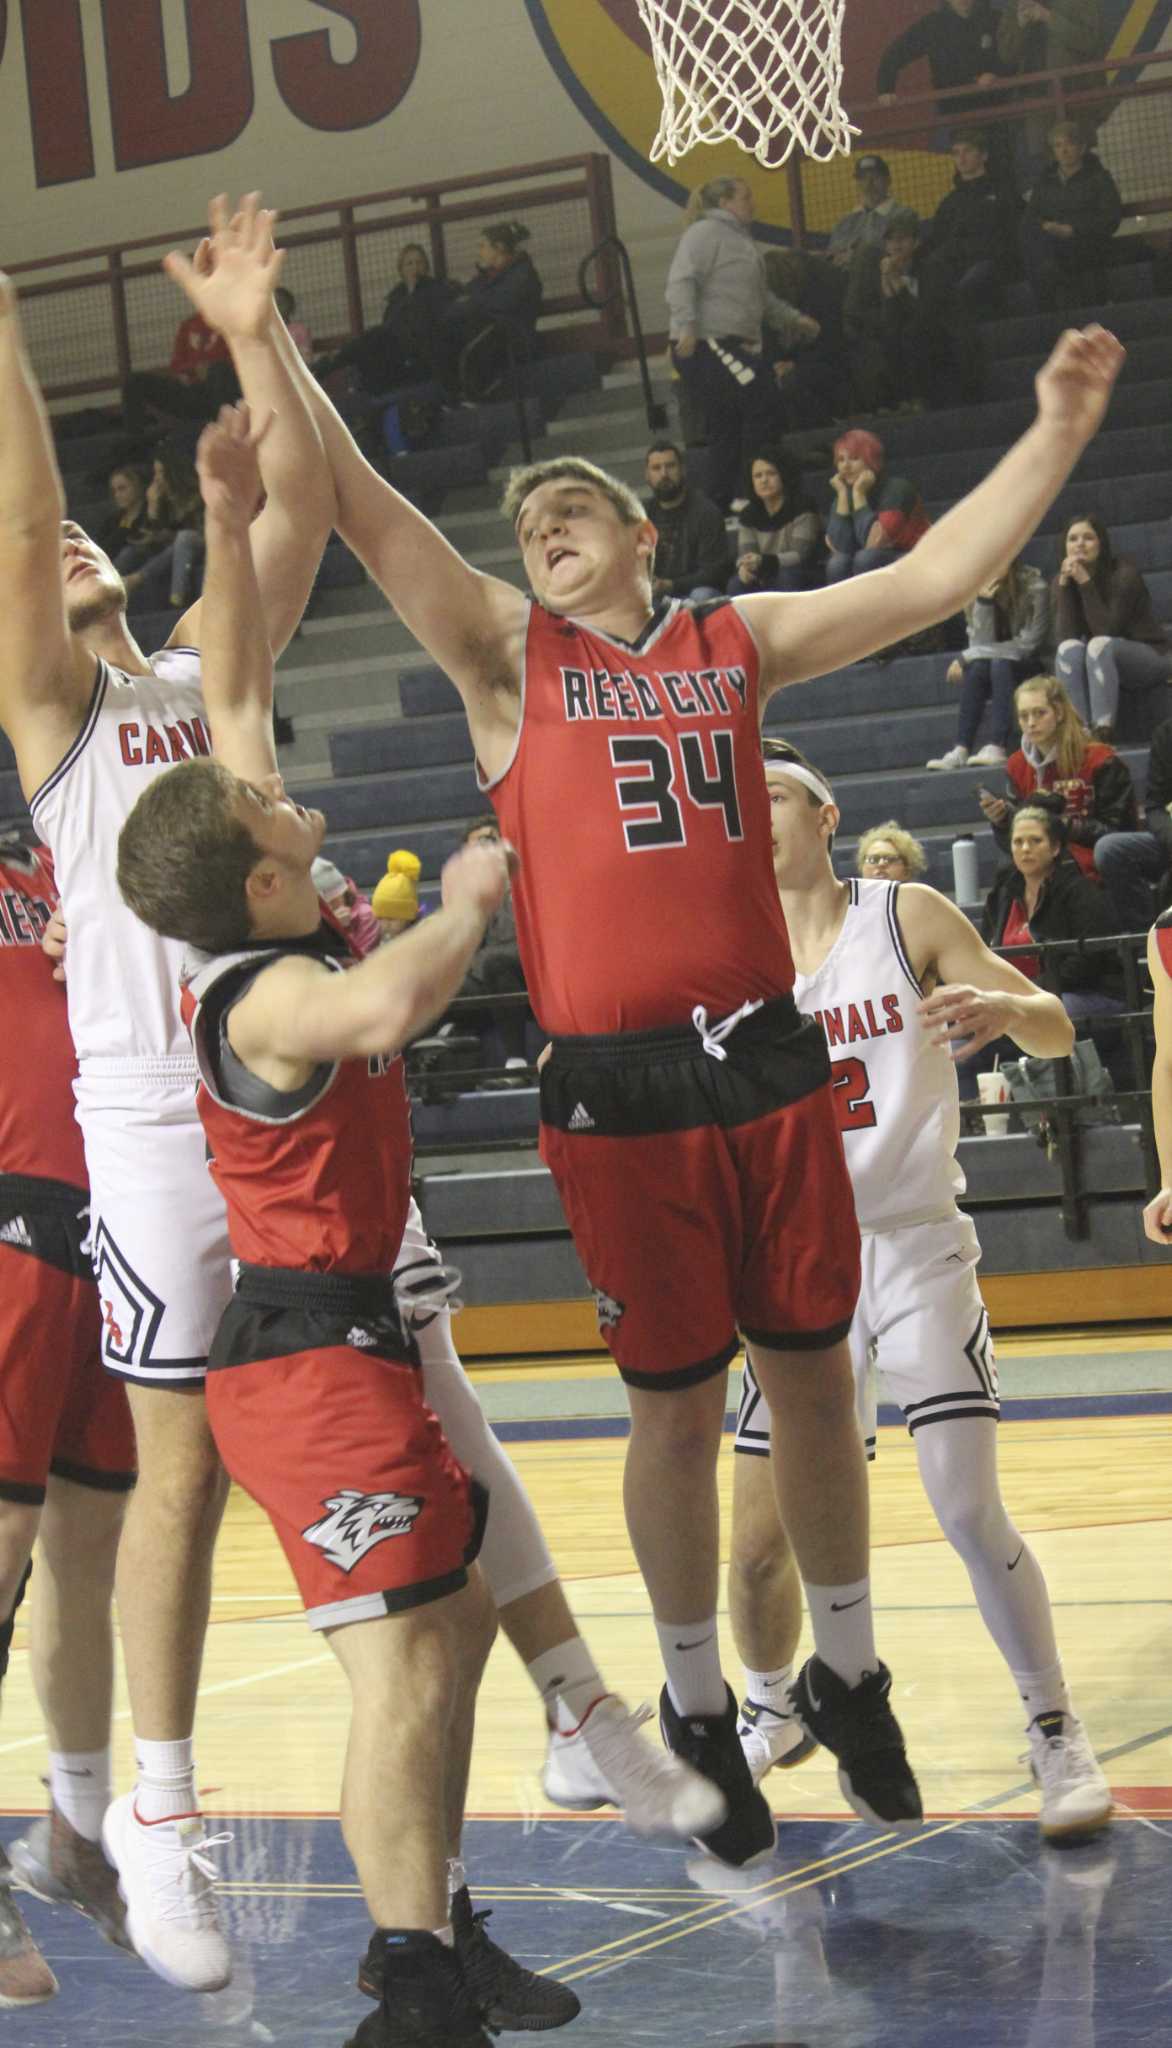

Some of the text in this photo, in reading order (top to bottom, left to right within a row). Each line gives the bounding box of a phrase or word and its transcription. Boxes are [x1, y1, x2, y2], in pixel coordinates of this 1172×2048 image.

[0, 0, 422, 188] IDS
[559, 666, 747, 721] REED CITY
[608, 729, 744, 853] 34
[831, 1056, 877, 1131] 2
